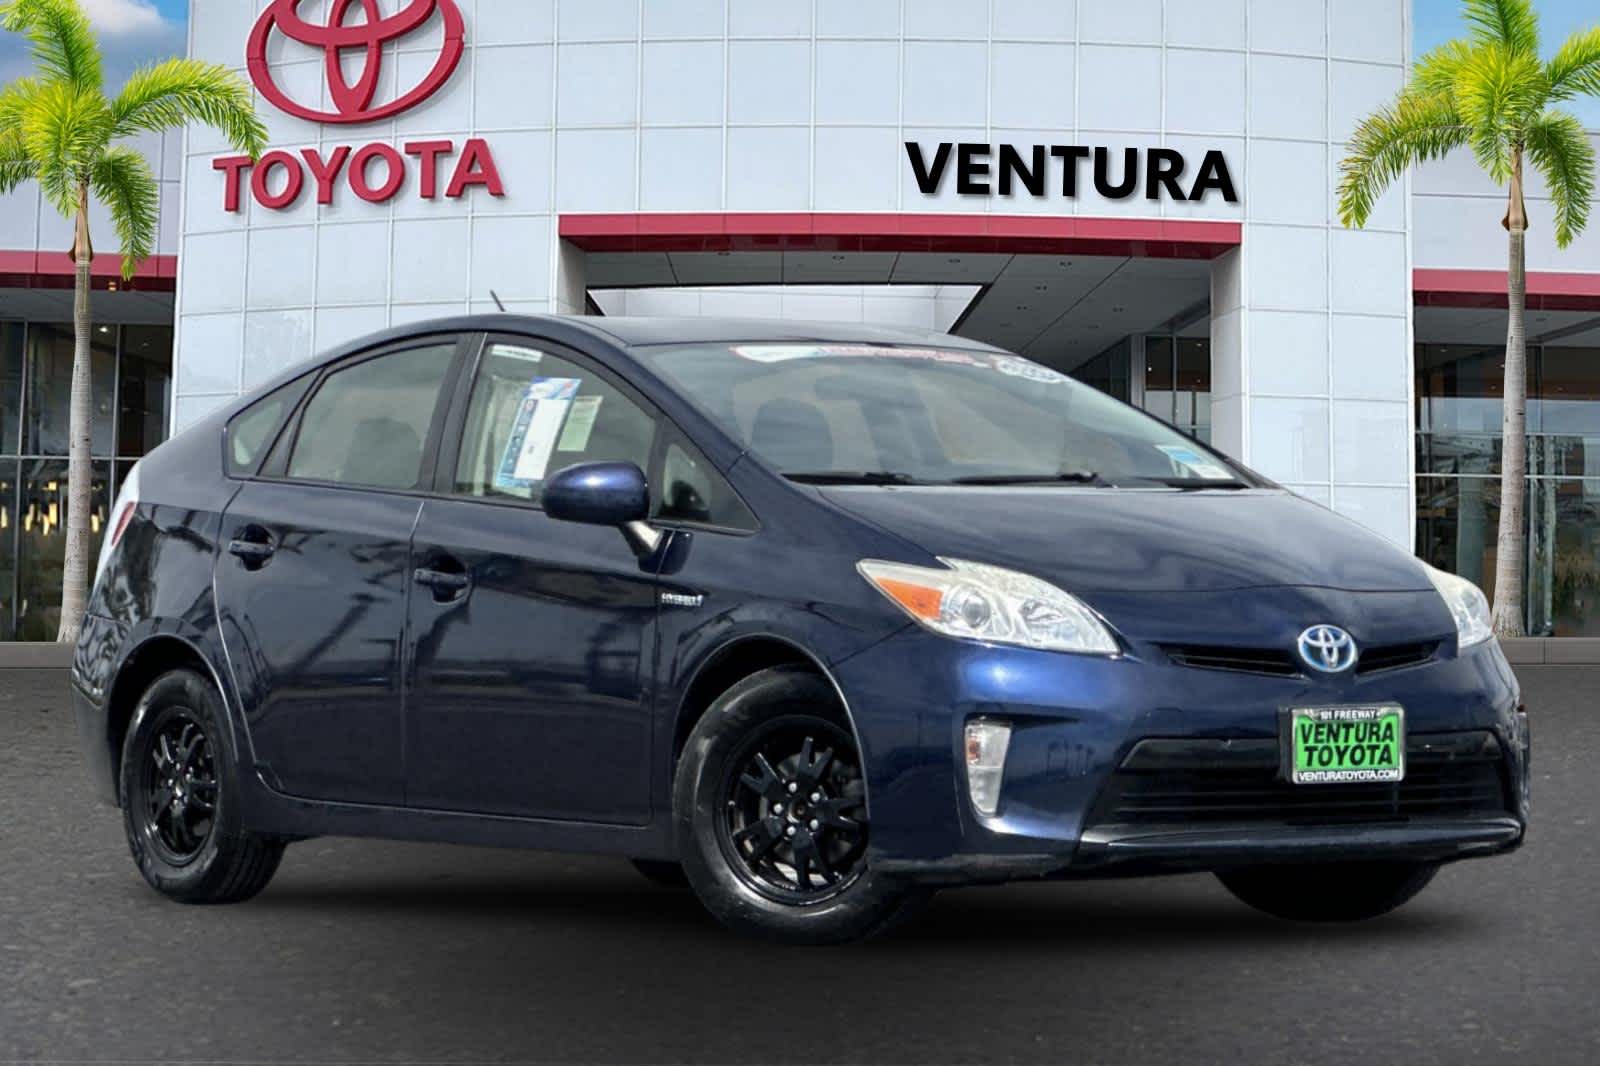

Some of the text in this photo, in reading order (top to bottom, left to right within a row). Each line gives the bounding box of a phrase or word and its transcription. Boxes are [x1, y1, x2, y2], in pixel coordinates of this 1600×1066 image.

[213, 139, 505, 212] TOYOTA
[905, 142, 1238, 202] VENTURA
[1334, 710, 1376, 720] FREEWAY
[1301, 722, 1394, 744] VENTURA
[1304, 744, 1393, 767] TOYOTA
[1299, 770, 1398, 781] VENTURATOYOTA.COM
